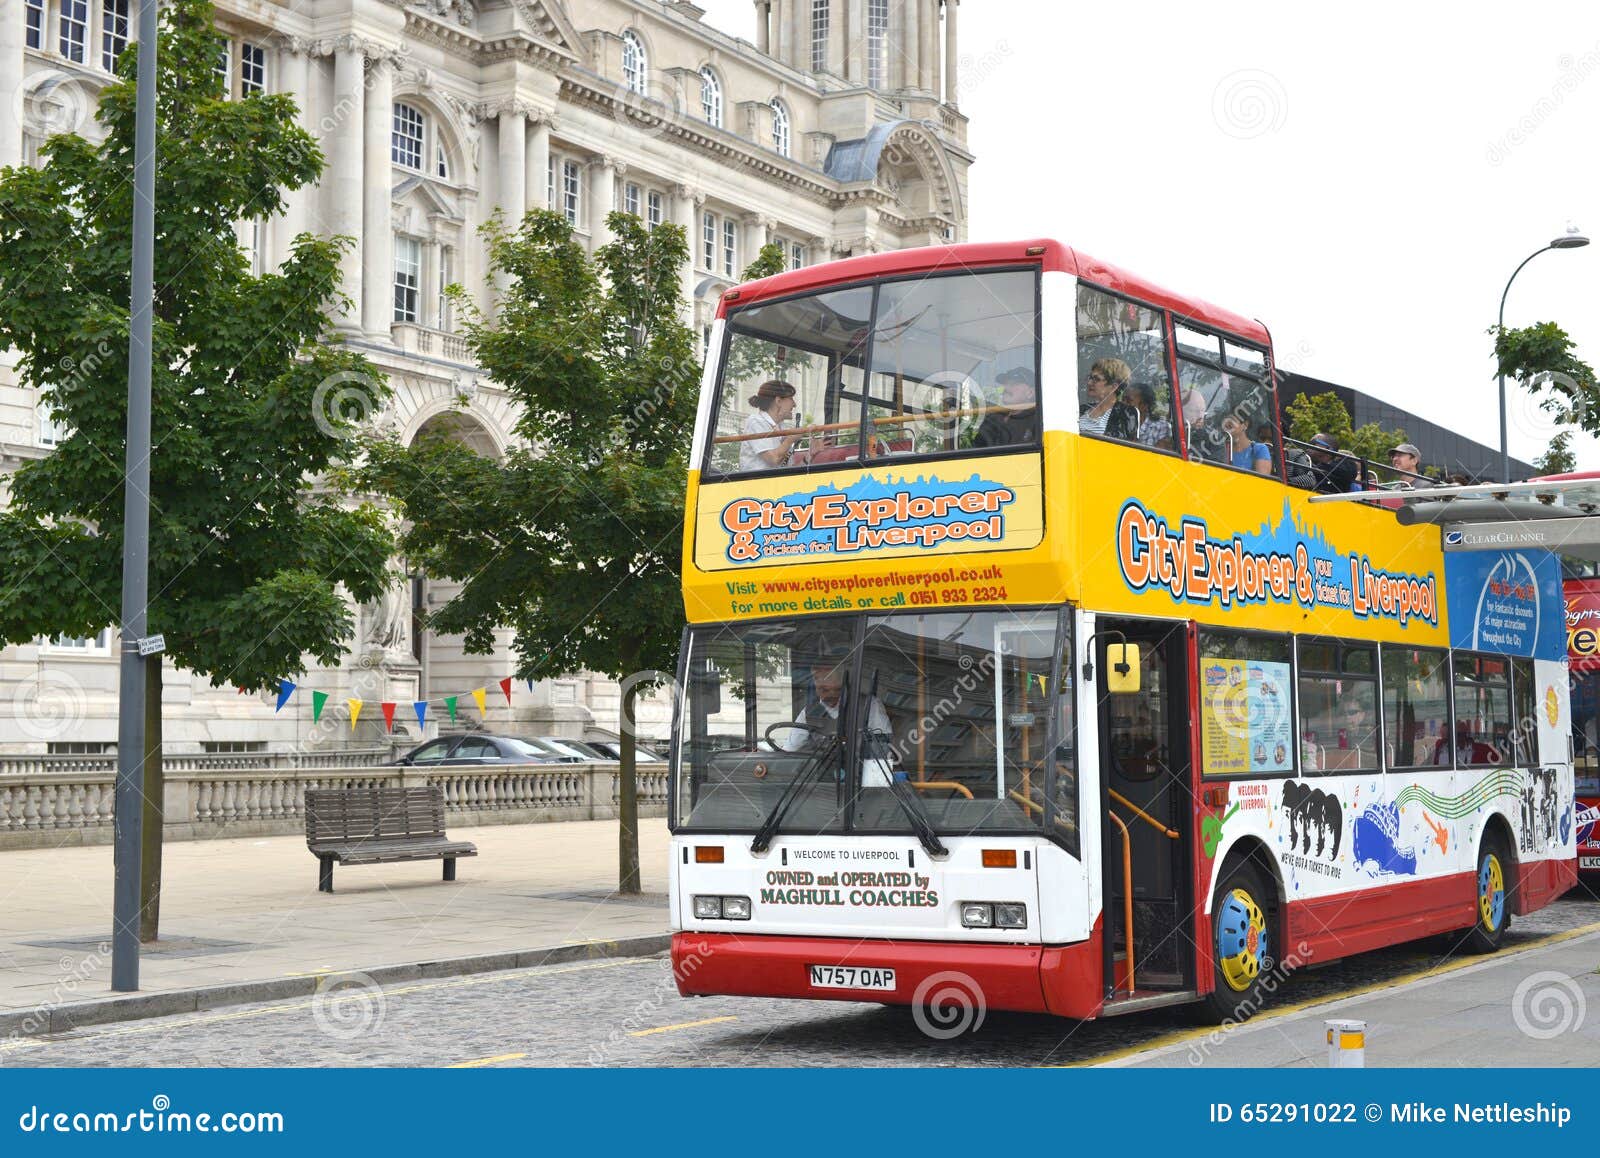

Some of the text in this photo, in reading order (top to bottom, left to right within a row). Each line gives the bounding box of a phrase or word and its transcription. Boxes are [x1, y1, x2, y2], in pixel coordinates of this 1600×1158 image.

[729, 530, 799, 561] & your
[762, 516, 1002, 558] ticket for Liverpool
[1295, 544, 1315, 604] &
[1313, 555, 1334, 579] your
[726, 564, 1003, 596] Visit www.cityexplorerliverpool.co.uk
[1315, 556, 1437, 624] ticket for Liverpool
[731, 586, 1008, 615] for more details or call 0151 933 2324
[1238, 784, 1268, 796] WELCOME TO
[1240, 798, 1266, 811] LIVERPOOL
[793, 849, 901, 861] WELCOME TO LIVERPOOL
[766, 871, 930, 891] OWNED and OPERATED by
[1308, 860, 1324, 875] TICKET
[1324, 864, 1331, 877] TO
[1331, 866, 1342, 879] RIDE
[760, 889, 939, 908] MAGHULL COACHES
[811, 966, 895, 988] N757 OAP
